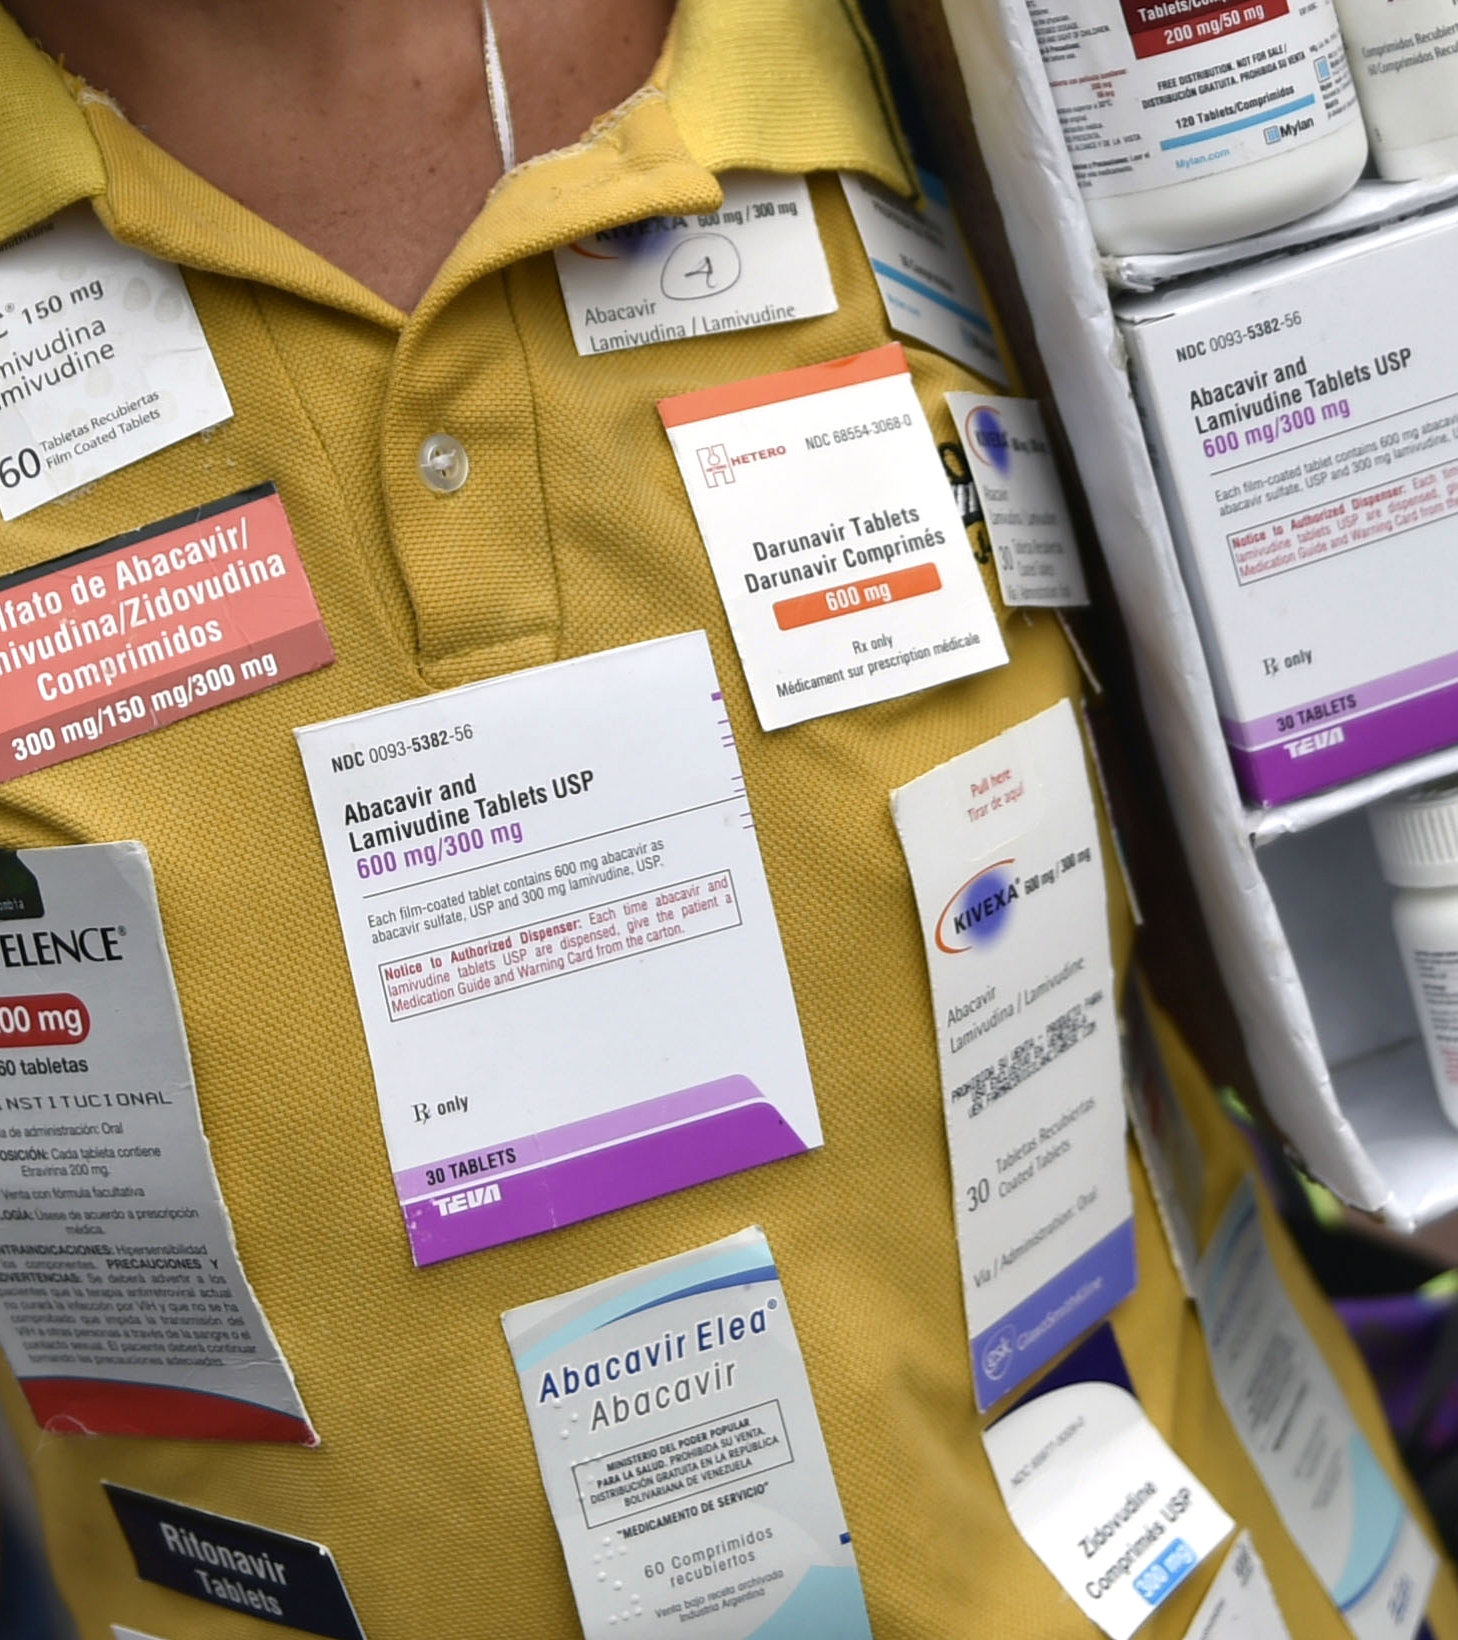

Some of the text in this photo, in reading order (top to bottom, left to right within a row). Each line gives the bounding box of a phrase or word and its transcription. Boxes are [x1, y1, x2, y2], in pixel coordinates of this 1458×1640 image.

[1164, 5, 1264, 45] 200 mg/50 mg
[1280, 118, 1314, 137] Mylan
[22, 295, 62, 324] 150
[70, 280, 104, 304] mg
[585, 299, 656, 326] Abacavir
[1191, 356, 1307, 410] Abacavir and
[1195, 348, 1411, 434] Lamivudine Tablets USP
[40, 392, 159, 452] Tabletas Recubiertas
[46, 409, 160, 469] Film Coated Tablets
[1203, 399, 1350, 458] 600 mg/300 mg
[730, 446, 786, 466] HETERO
[71, 575, 106, 605] de
[116, 517, 247, 590] Abacavir/
[744, 528, 946, 594] Darunavir Comprimés
[753, 509, 920, 562] Darunavir Tablets
[826, 583, 892, 611] 600 mg
[37, 620, 222, 701] Comprimidos
[776, 633, 980, 697] Médicament sur prescription médicale
[12, 653, 278, 761] 300 mg/150 mg/300 mg
[331, 724, 473, 773] NDC 0093-5382-56
[1287, 728, 1344, 758] TEVA
[345, 773, 477, 826] Abacavir and
[349, 770, 593, 852] Lamivudine Tablets USP
[357, 822, 523, 879] 600 mg/300 mg
[367, 840, 664, 928] Each film-coated tablet contains 600 mg abacavir as
[952, 880, 1018, 934] KIVEXA
[38, 1009, 83, 1036] mg
[20, 1058, 88, 1075] tabletas
[426, 1148, 516, 1186] 30 TABLETS
[432, 1183, 503, 1218] TEVA
[540, 1336, 684, 1403] Abacavir
[592, 1363, 735, 1432] Abacavir
[161, 1522, 286, 1585] Ritonavir
[644, 1528, 773, 1578] 60 Comprimidos
[670, 1551, 755, 1587] recubiertos
[200, 1571, 283, 1616] Tablets
